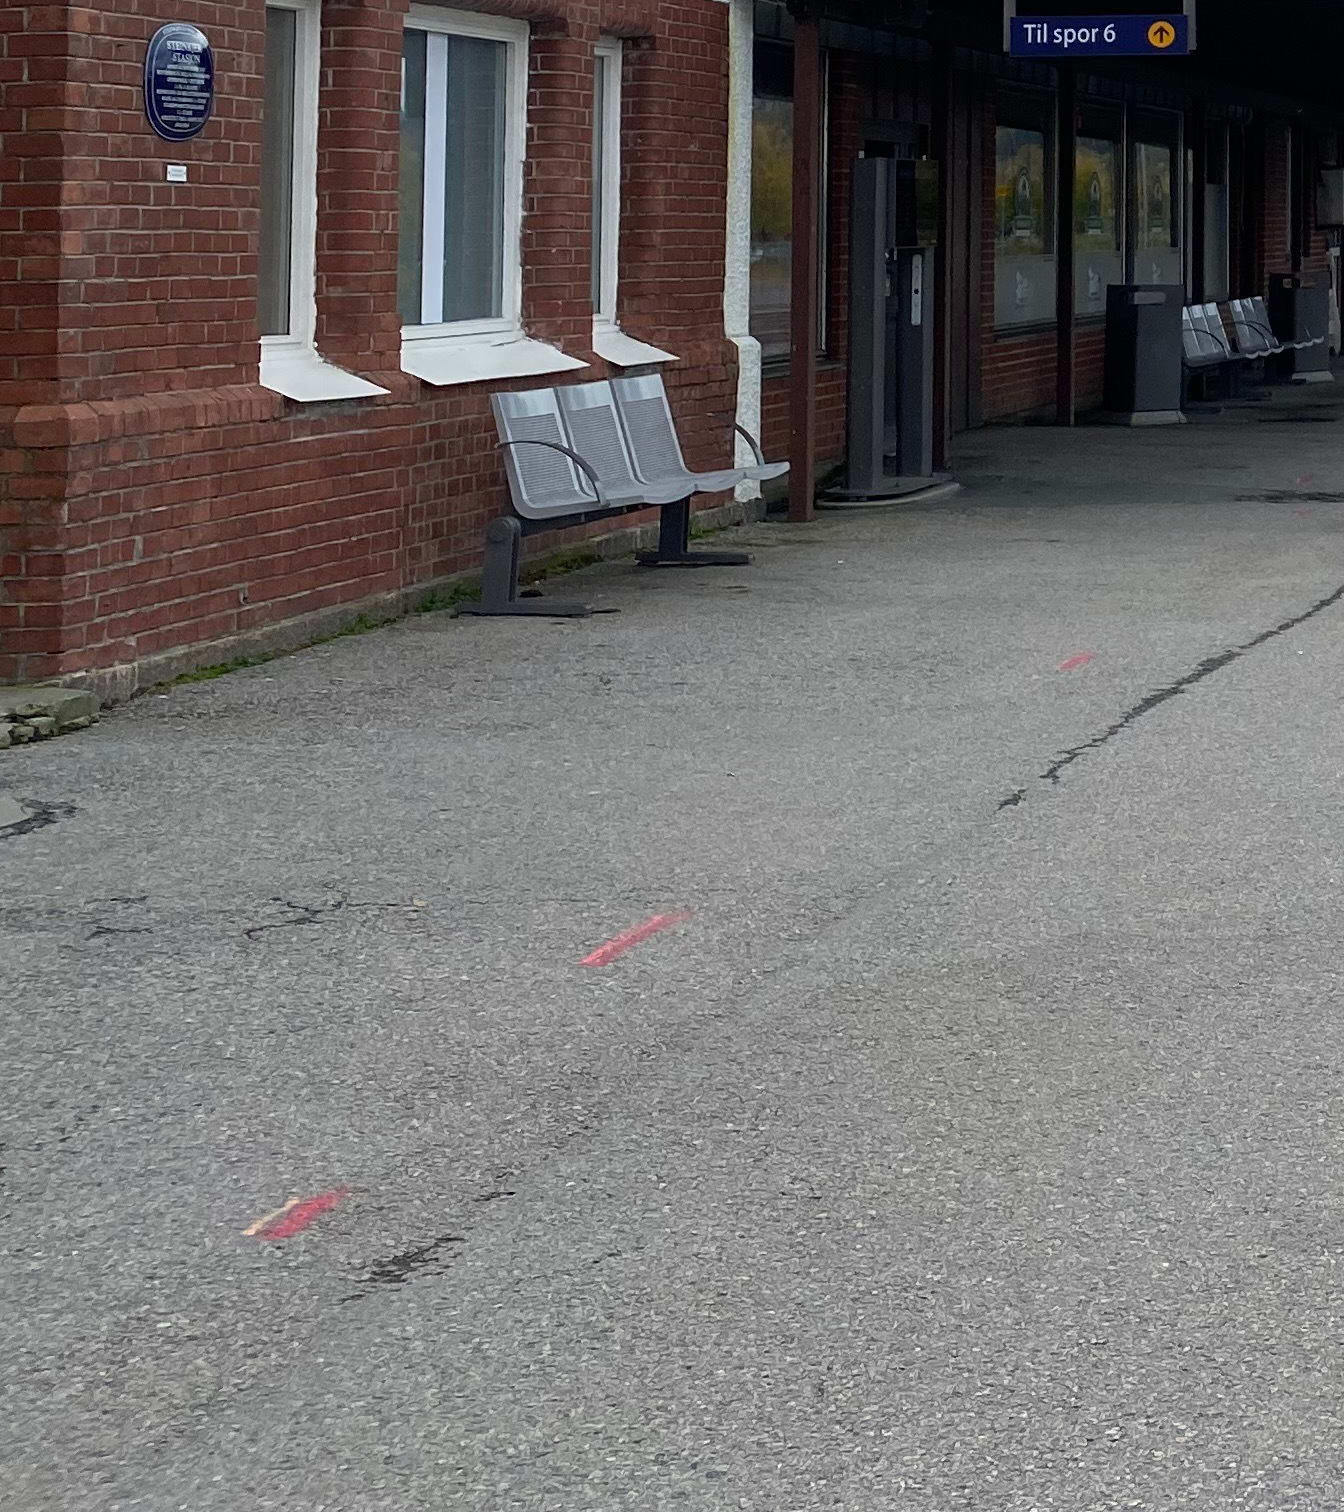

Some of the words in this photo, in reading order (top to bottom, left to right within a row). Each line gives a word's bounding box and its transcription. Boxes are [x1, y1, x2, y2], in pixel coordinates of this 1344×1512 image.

[1023, 23, 1048, 44] Til
[1053, 27, 1099, 48] spor
[1103, 23, 1116, 43] 6
